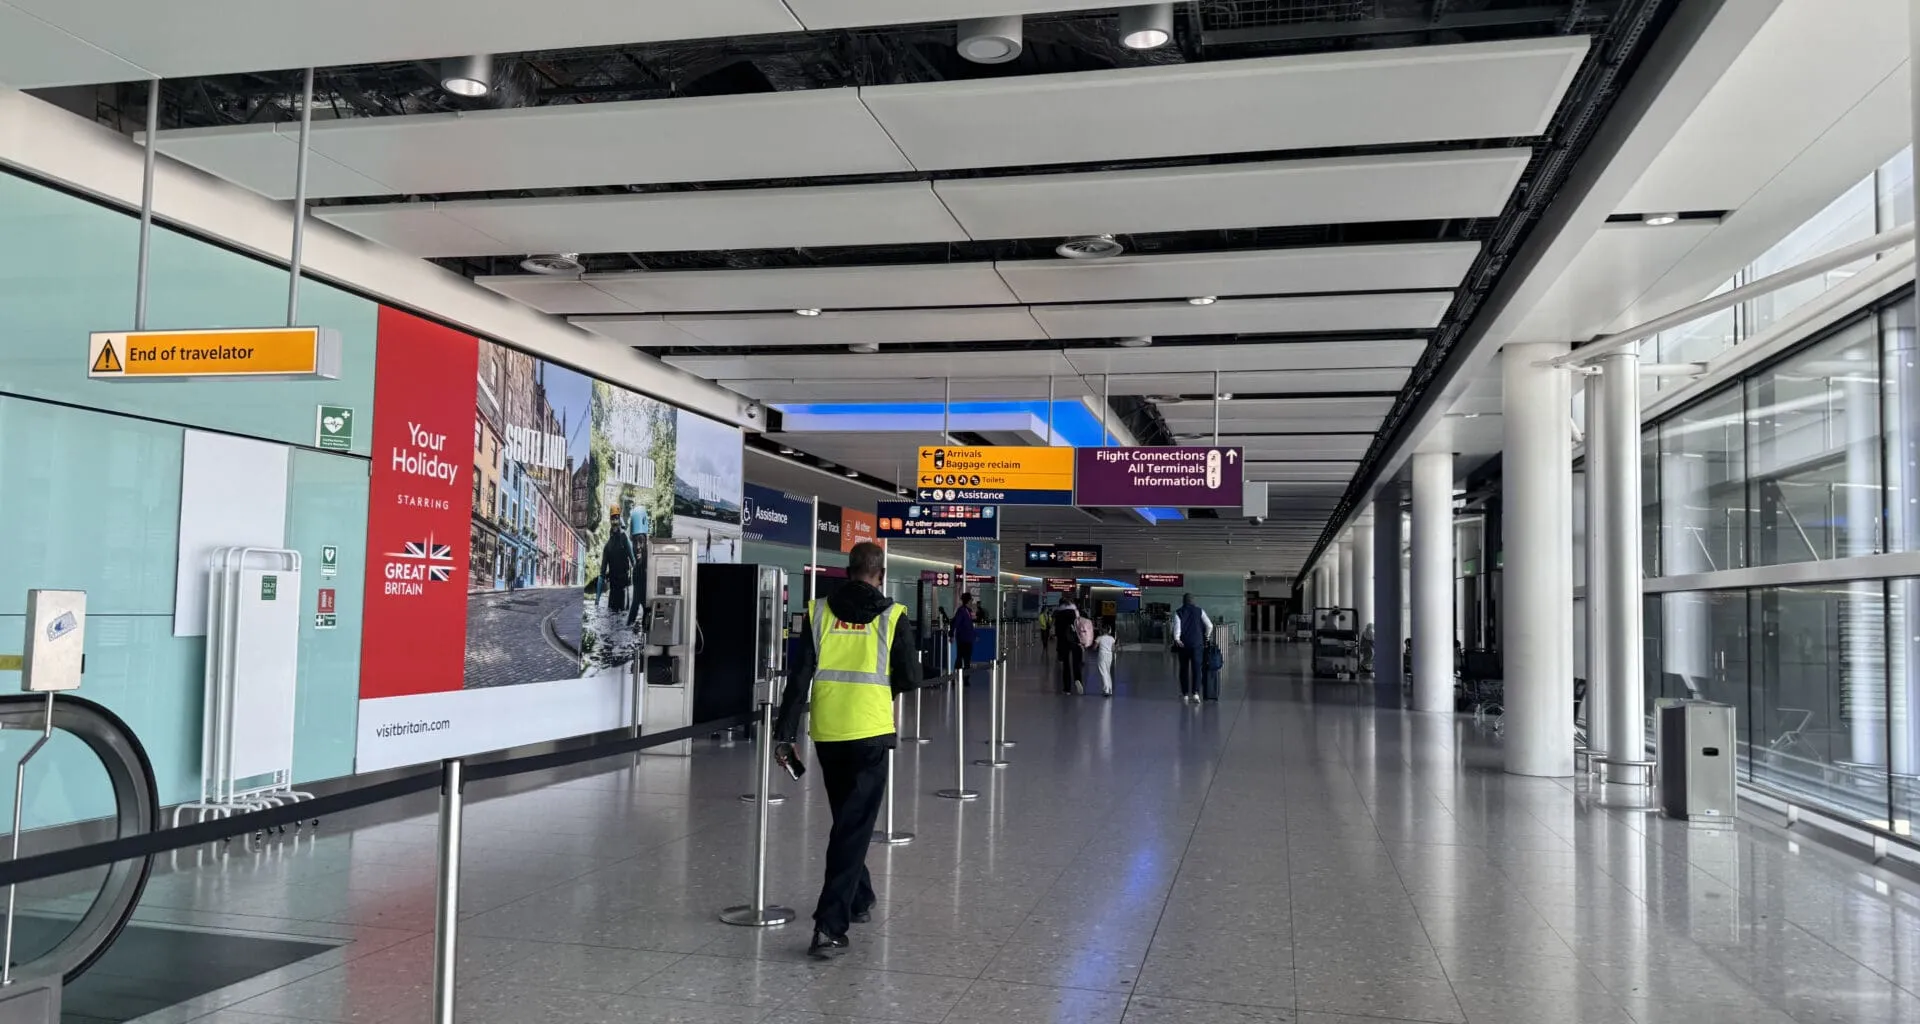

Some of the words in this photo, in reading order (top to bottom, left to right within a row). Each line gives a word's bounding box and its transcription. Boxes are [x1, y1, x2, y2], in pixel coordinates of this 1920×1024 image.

[130, 347, 156, 361] End
[161, 346, 176, 360] of
[179, 345, 254, 361] travelator
[408, 421, 446, 451] Your
[504, 423, 566, 471] SCOTLAND
[946, 450, 982, 458] Arrivals
[1097, 450, 1129, 463] Flight
[1132, 450, 1206, 461] Connections
[392, 447, 458, 485] Holiday
[615, 450, 655, 488] ENGLAND
[946, 460, 985, 470] Baggage
[987, 460, 1021, 469] reclaim
[1128, 463, 1144, 473] All
[1146, 463, 1205, 474] Terminals
[982, 476, 1005, 484] Toilets
[1134, 476, 1205, 487] Information
[957, 490, 1004, 499] Assistance
[397, 494, 449, 510] STARRING
[755, 506, 788, 524] Assistance
[817, 520, 828, 531] Fast
[828, 521, 840, 534] Track
[915, 520, 933, 528] other
[384, 562, 426, 580] GREAT
[384, 582, 423, 595] BRITAIN
[376, 719, 450, 737] visitbritain.com
